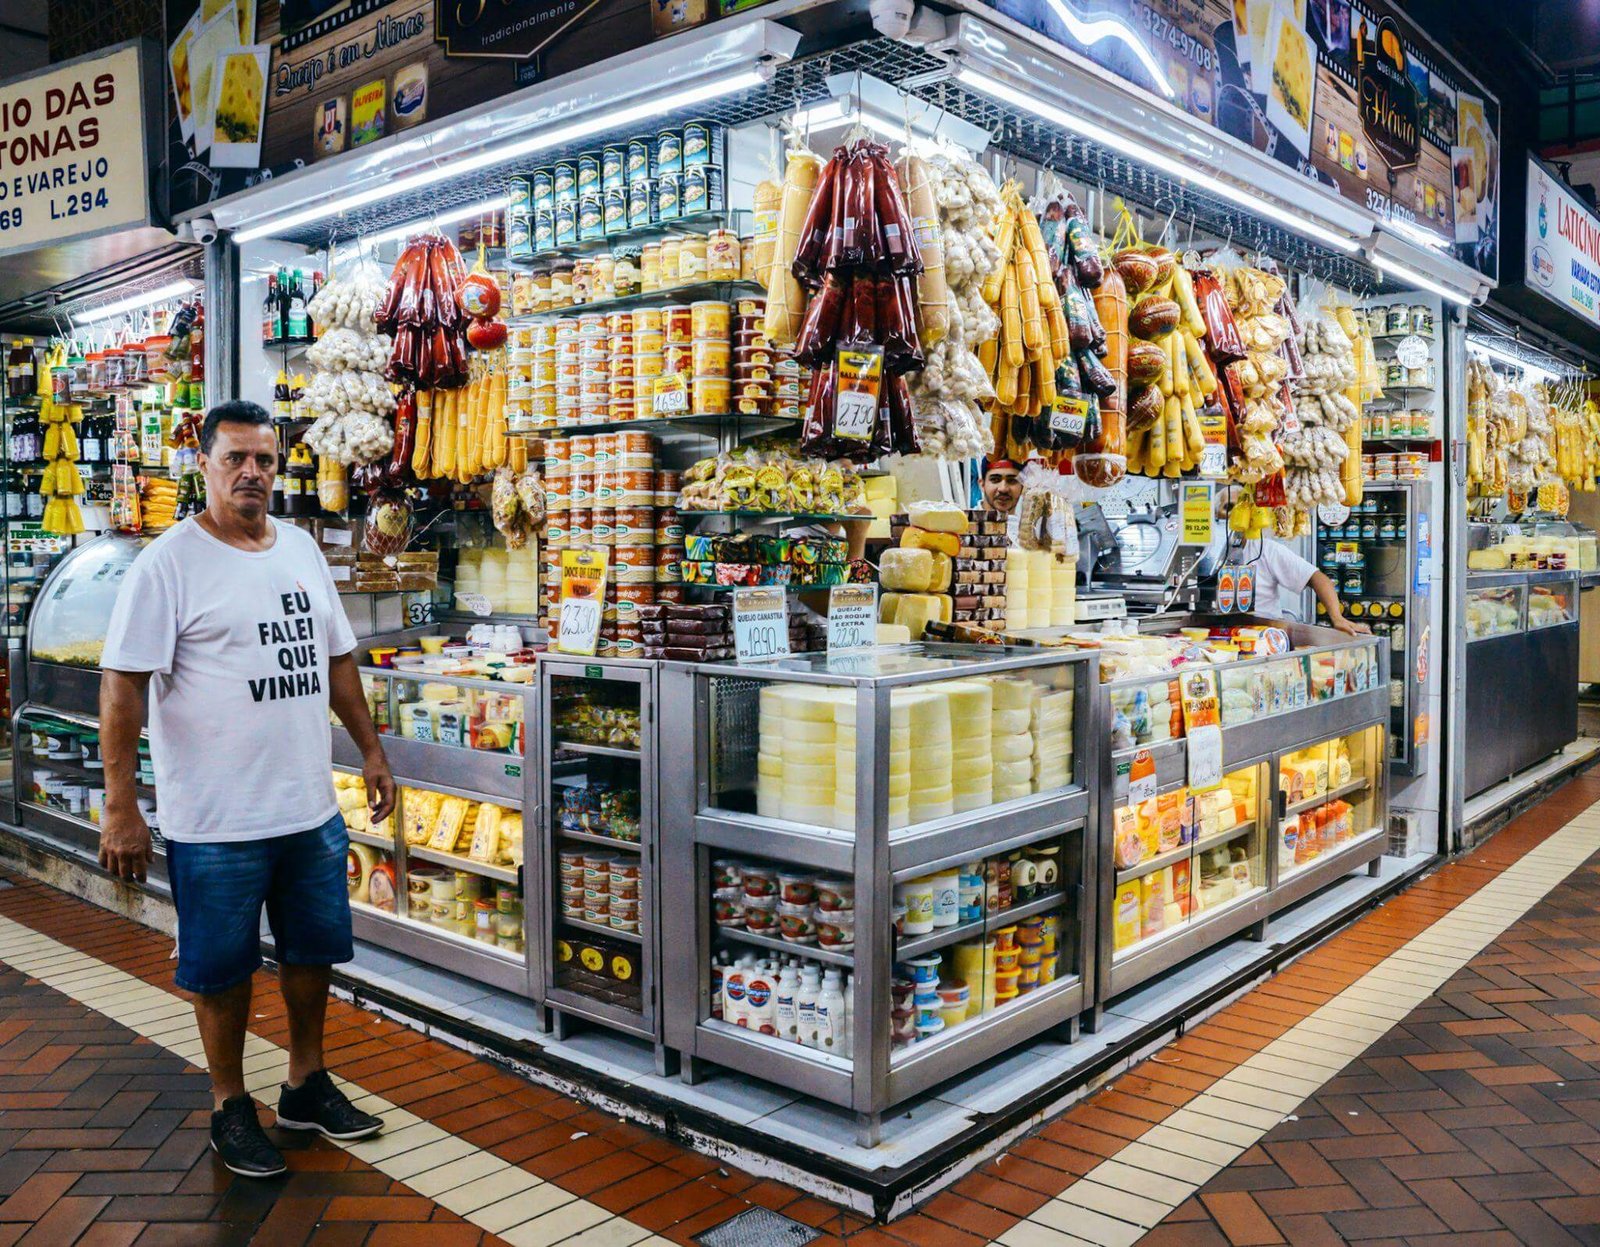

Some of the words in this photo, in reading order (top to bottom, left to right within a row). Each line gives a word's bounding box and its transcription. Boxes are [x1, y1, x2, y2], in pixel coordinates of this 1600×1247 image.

[481, 1, 576, 47] tradicionalmente
[275, 59, 323, 96] Queijo
[327, 46, 336, 74] é
[338, 42, 361, 71] em
[363, 12, 424, 56] Minas
[46, 73, 114, 120] DAS
[14, 177, 23, 197] E
[28, 157, 108, 194] VAREJO
[51, 187, 109, 220] L.294
[1056, 403, 1083, 414] COPA
[281, 591, 311, 615] EU
[737, 613, 756, 622] QUEIJO
[757, 612, 783, 621] CANASTRA
[258, 617, 314, 645] FALEI
[278, 644, 317, 672] QUE
[248, 671, 321, 702] VINHA
